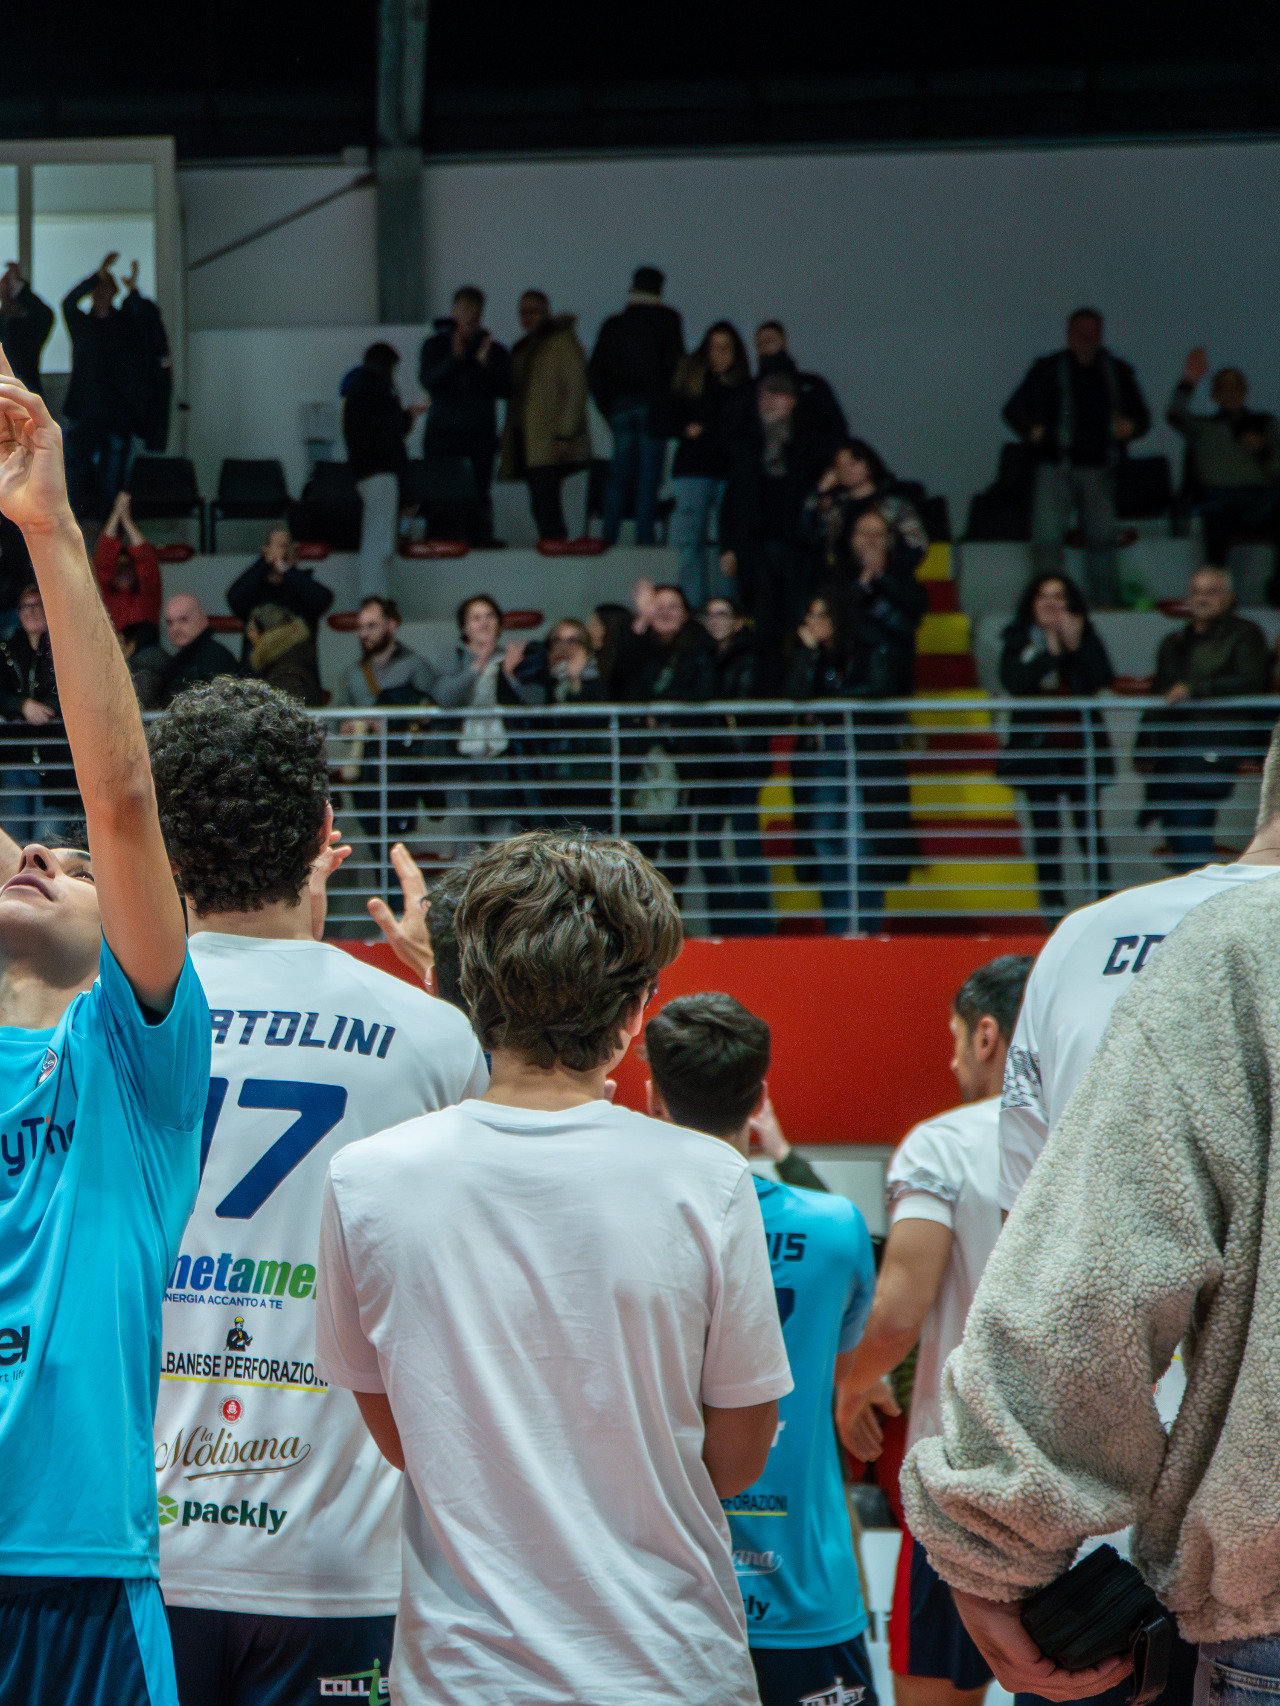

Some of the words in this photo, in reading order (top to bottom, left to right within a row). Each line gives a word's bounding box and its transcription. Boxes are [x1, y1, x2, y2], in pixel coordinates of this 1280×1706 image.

[208, 1008, 397, 1060] RTOLINI
[163, 1292, 206, 1304] NERGIA
[207, 1295, 258, 1308] ACCANTO
[259, 1300, 267, 1308] A
[268, 1299, 283, 1310] TE
[155, 1425, 311, 1475] Molisana
[200, 1427, 214, 1442] la
[181, 1500, 288, 1536] packly
